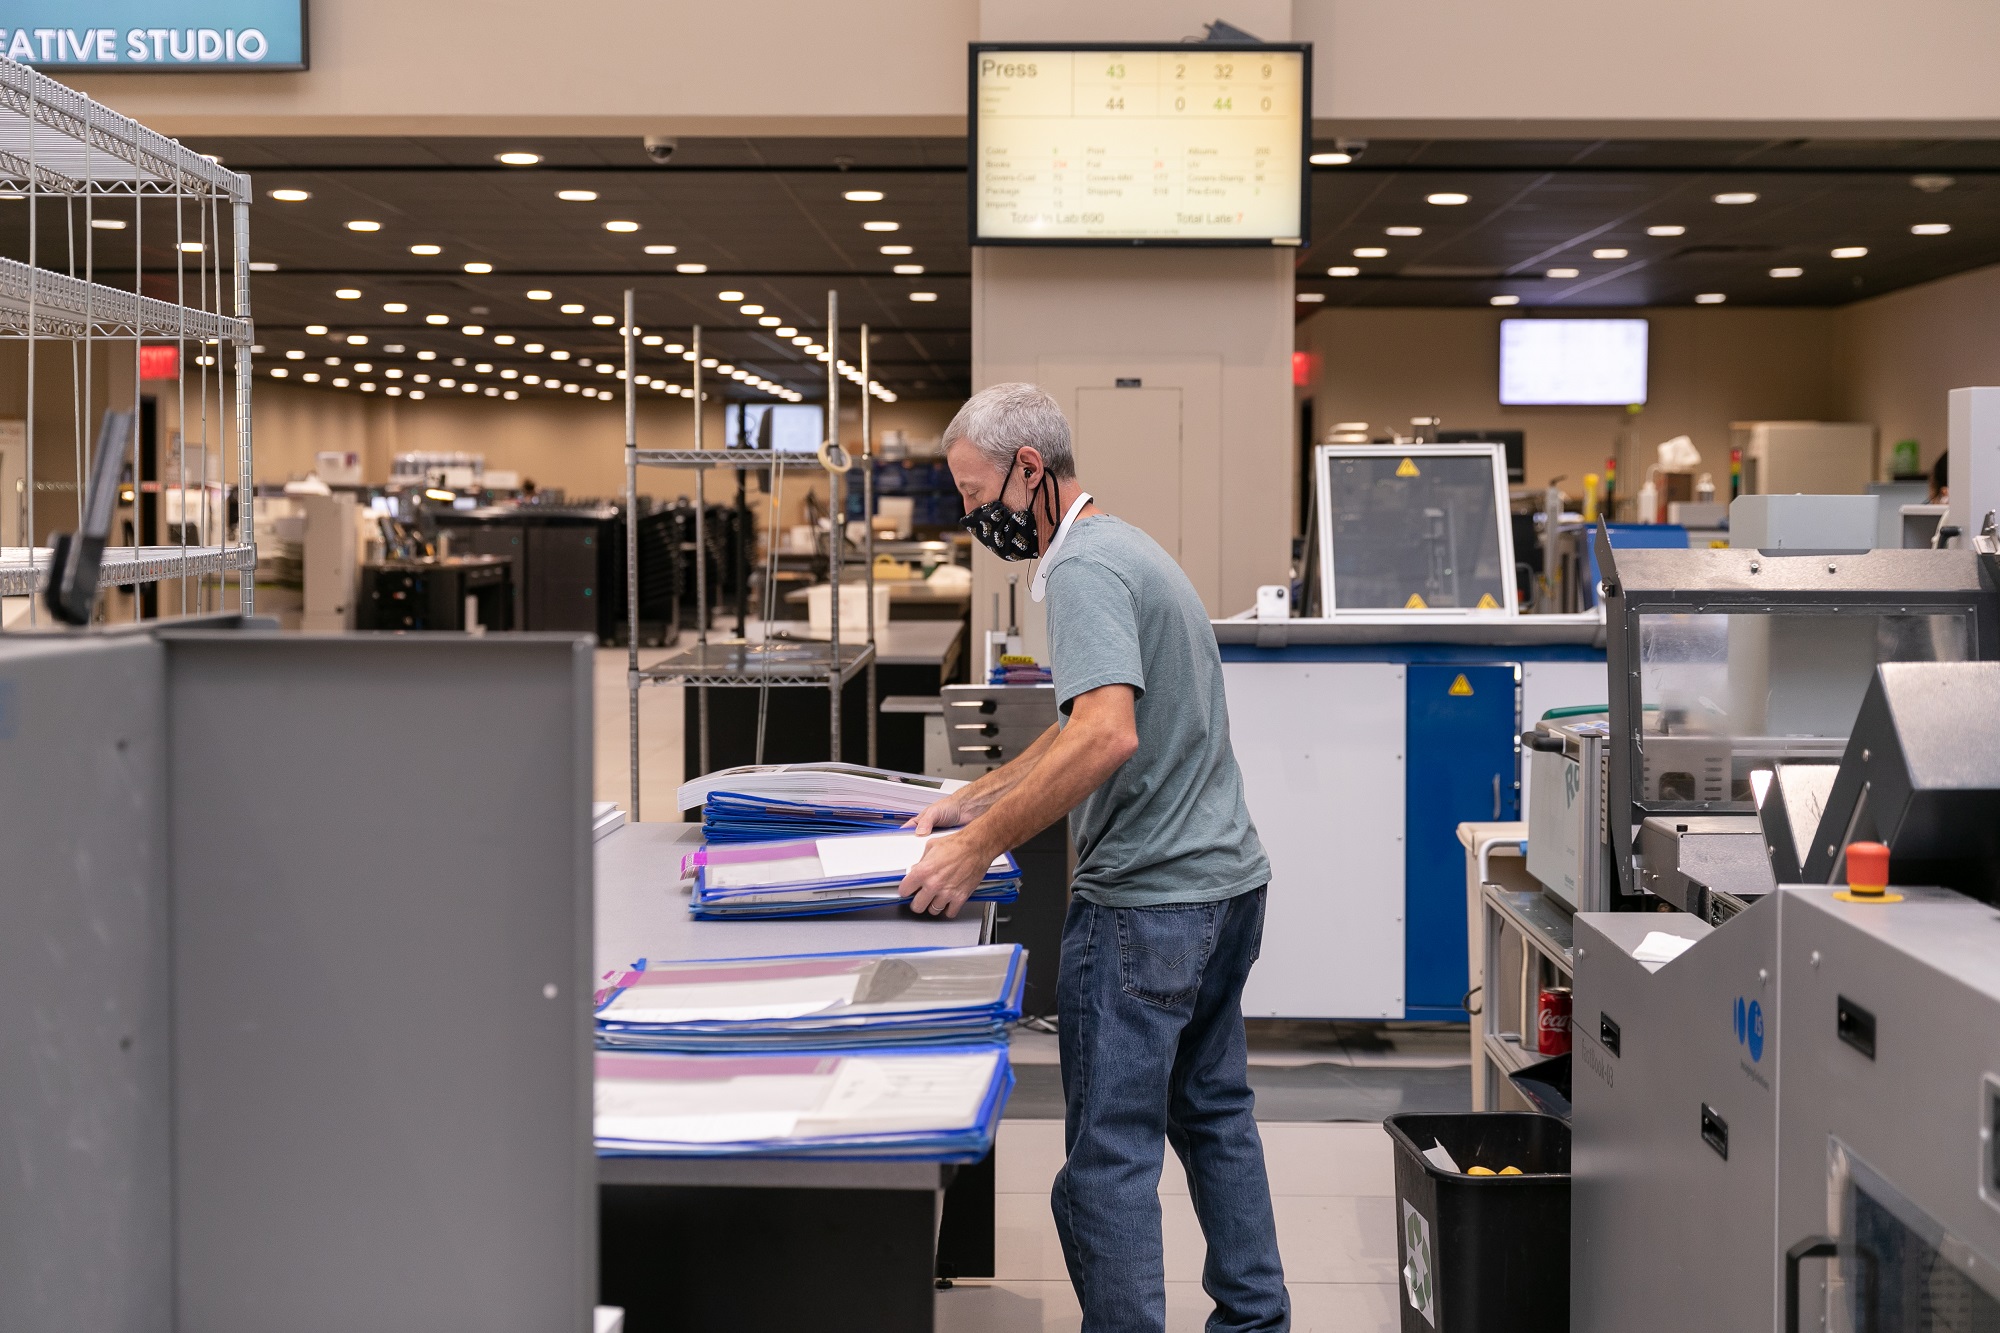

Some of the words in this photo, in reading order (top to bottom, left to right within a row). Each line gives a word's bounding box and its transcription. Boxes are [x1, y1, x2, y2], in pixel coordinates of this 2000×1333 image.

[0, 28, 117, 62] ATIVE
[126, 28, 268, 62] STUDIO
[981, 59, 1038, 79] Press
[1105, 64, 1126, 80] 43
[1175, 64, 1186, 80] 2
[1214, 64, 1234, 80] 32
[1261, 64, 1272, 80] 9
[1105, 96, 1125, 111] 44
[1175, 96, 1186, 112] 0
[1213, 96, 1233, 111] 44
[1261, 96, 1272, 112] 0
[1011, 212, 1037, 224] Total
[1177, 212, 1203, 225] Total
